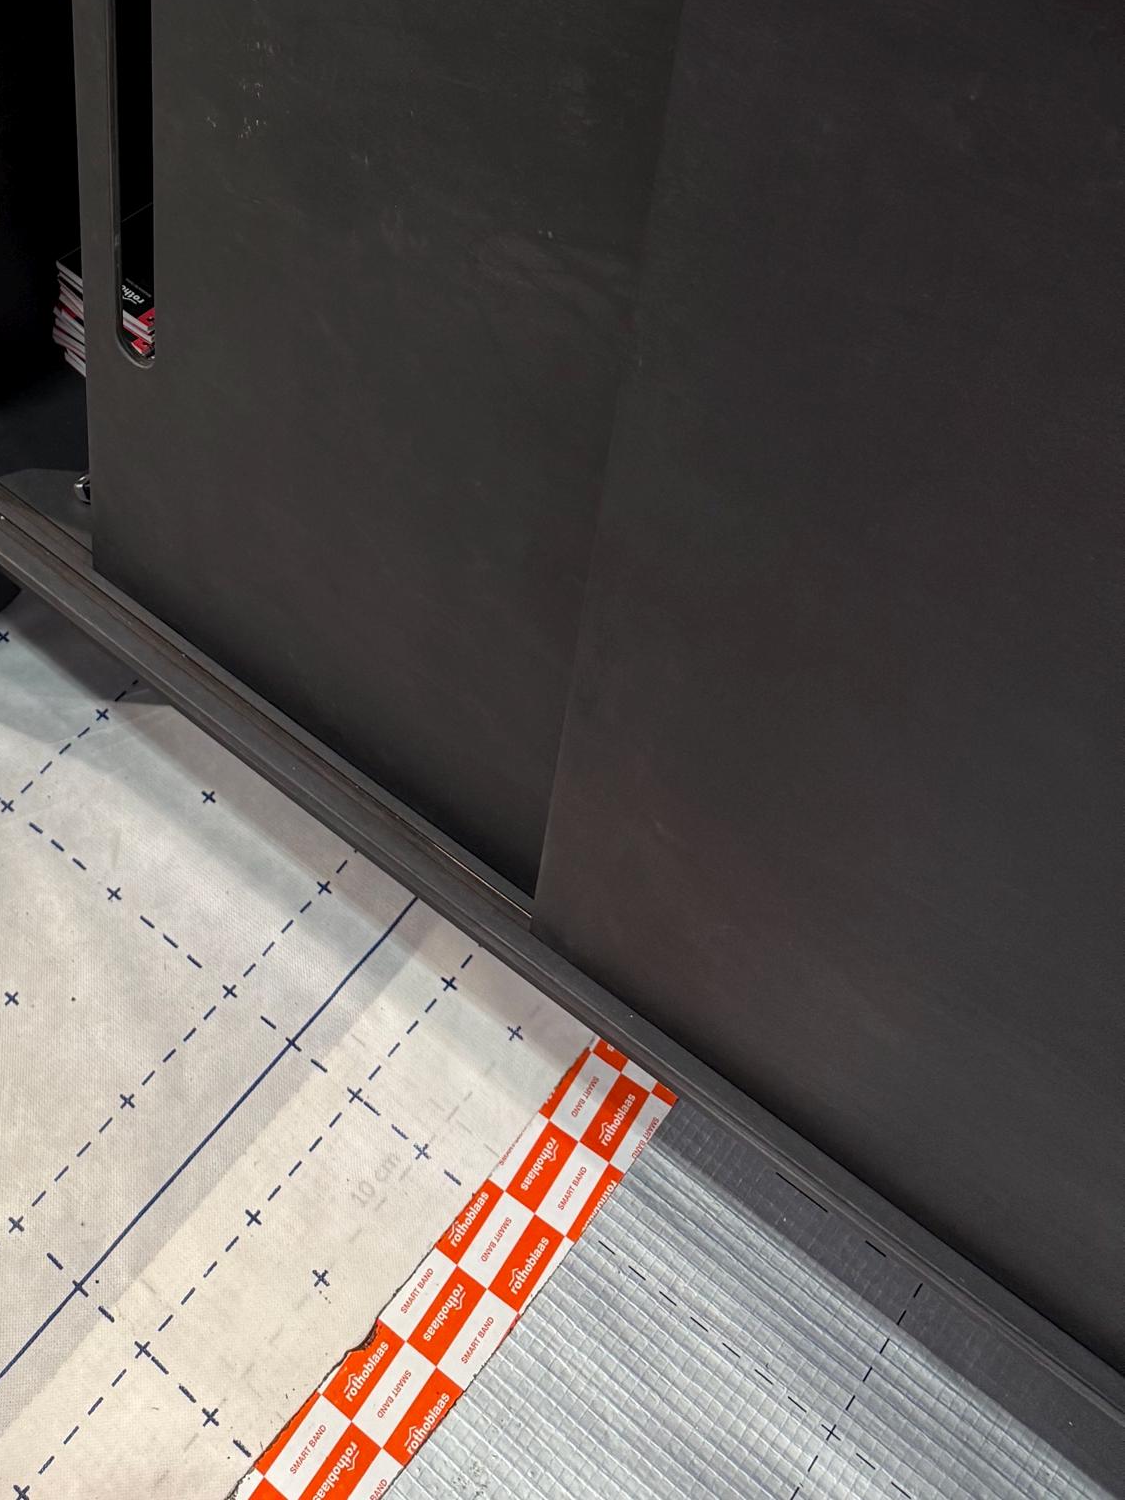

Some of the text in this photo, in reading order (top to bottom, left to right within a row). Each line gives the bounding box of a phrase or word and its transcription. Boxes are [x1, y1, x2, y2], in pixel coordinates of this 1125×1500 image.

[571, 1076, 600, 1117] SMART BAND
[601, 1094, 636, 1146] rothoblaas
[521, 1137, 556, 1191] rothoblaas
[558, 1166, 588, 1211] SMART BAND
[450, 1191, 489, 1247] rothoblaas
[481, 1216, 512, 1262] SMART BAND
[401, 1268, 434, 1314] SMART BAND
[509, 1236, 549, 1295] rothoblaas
[424, 1283, 464, 1341] rothoblaas
[461, 1316, 494, 1364] SMART BAND
[345, 1341, 389, 1403] rothoblaas
[377, 1370, 412, 1419] SMART BAND
[405, 1393, 450, 1454] rothoblaas
[290, 1424, 327, 1475] SMART BAND
